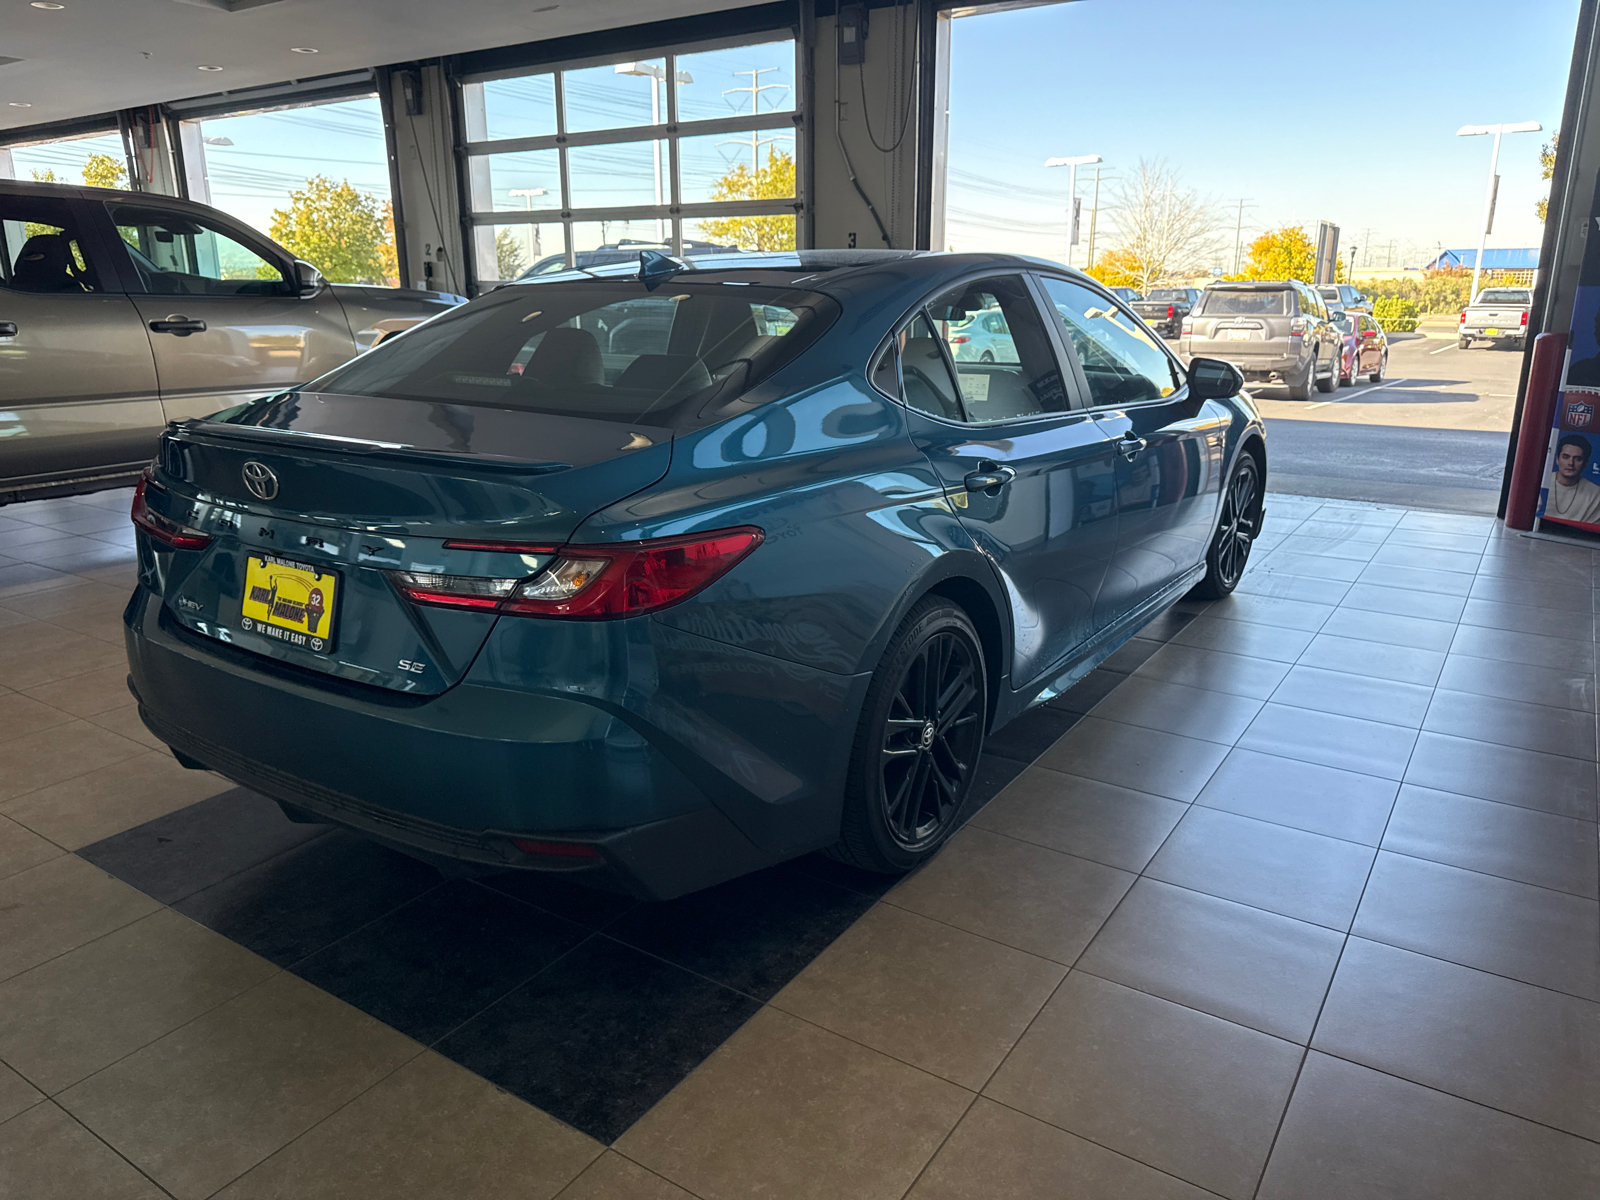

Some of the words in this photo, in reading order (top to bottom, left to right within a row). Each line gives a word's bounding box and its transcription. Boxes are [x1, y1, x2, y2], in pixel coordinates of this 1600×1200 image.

[848, 233, 857, 249] 3
[425, 244, 431, 256] 2
[1569, 412, 1589, 427] NFL
[265, 555, 276, 564] KARL
[277, 559, 295, 569] MALONE
[296, 563, 314, 572] TOYOTA
[249, 586, 271, 604] KARL
[311, 593, 321, 607] 32
[273, 602, 305, 624] MALONE
[257, 623, 266, 634] WE
[267, 626, 283, 638] MAKE
[284, 631, 290, 641] IT
[291, 633, 306, 645] EASY
[397, 659, 426, 674] SE
